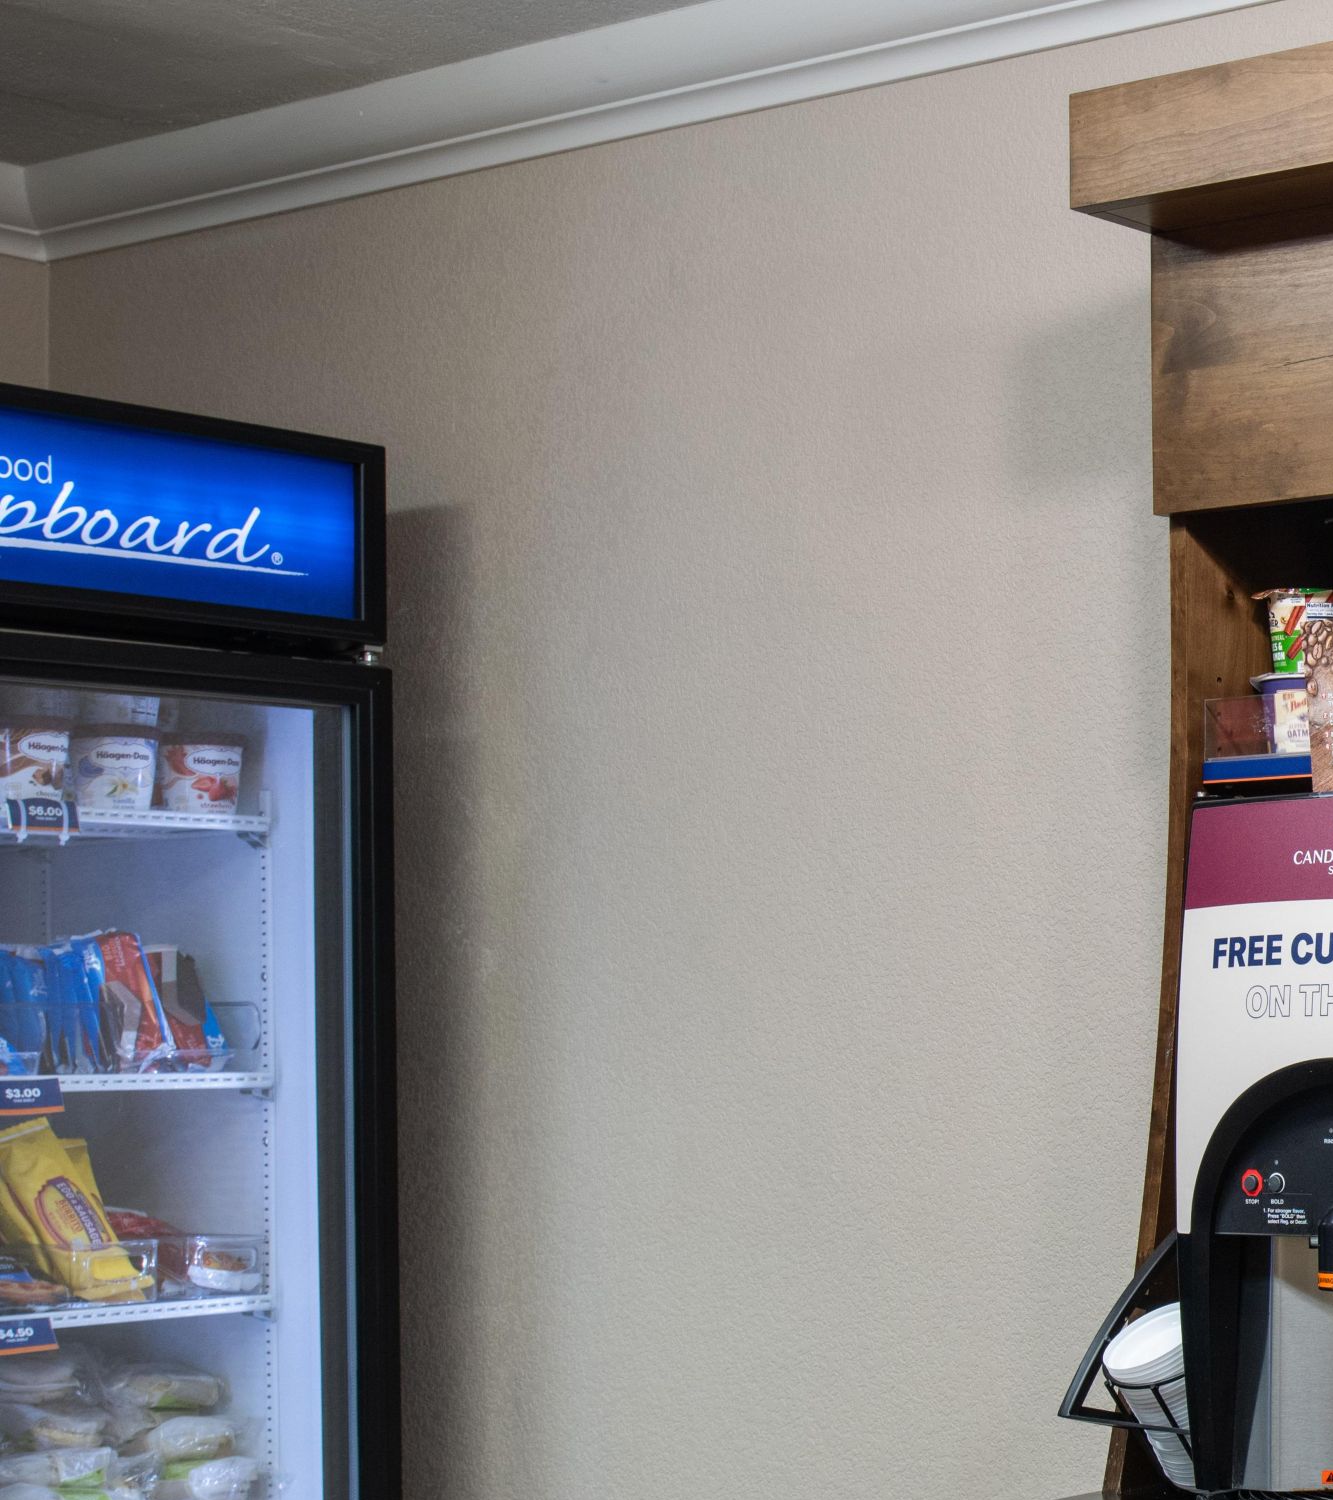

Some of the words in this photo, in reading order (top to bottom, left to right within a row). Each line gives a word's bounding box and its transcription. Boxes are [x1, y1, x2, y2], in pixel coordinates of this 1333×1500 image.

[1212, 933, 1283, 969] FREE
[1245, 984, 1292, 1019] ON
[5, 1087, 41, 1098] $3.00
